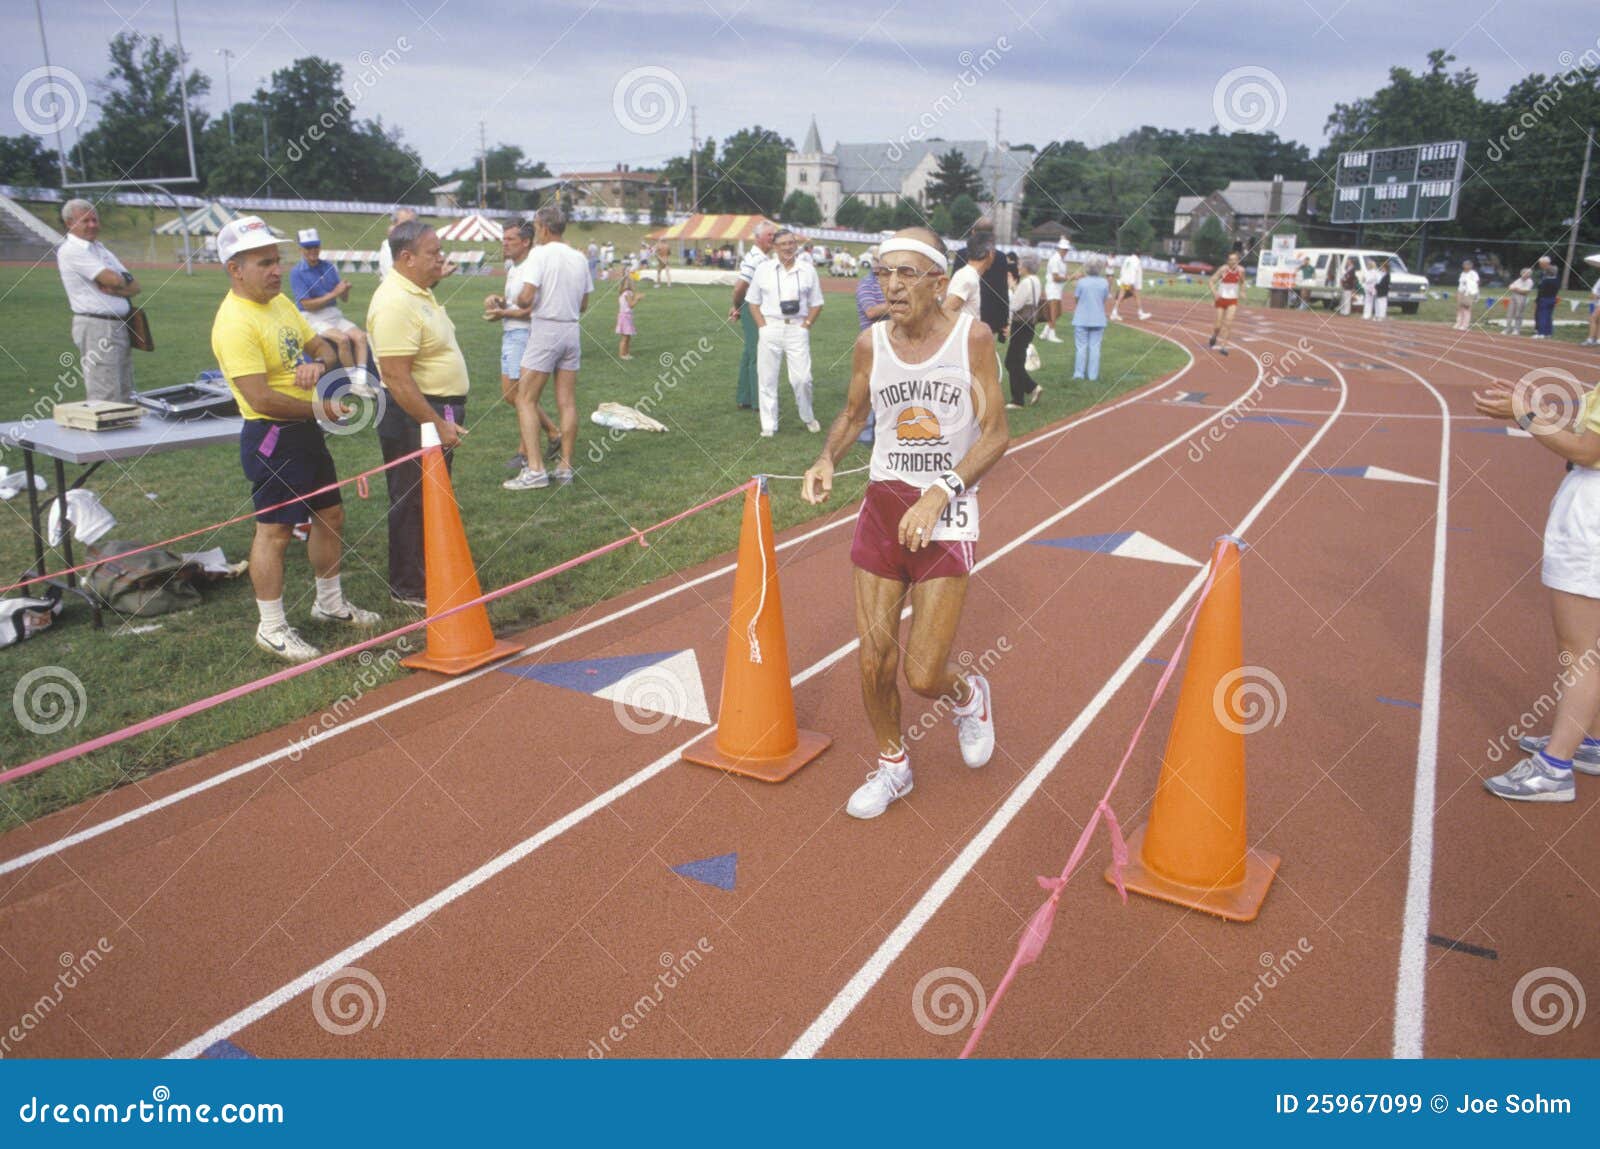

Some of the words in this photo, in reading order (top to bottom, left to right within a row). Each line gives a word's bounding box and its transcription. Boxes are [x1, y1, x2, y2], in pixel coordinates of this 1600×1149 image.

[879, 380, 962, 408] TIDEWATER
[886, 452, 953, 473] STRIDERS
[940, 501, 969, 528] 45
